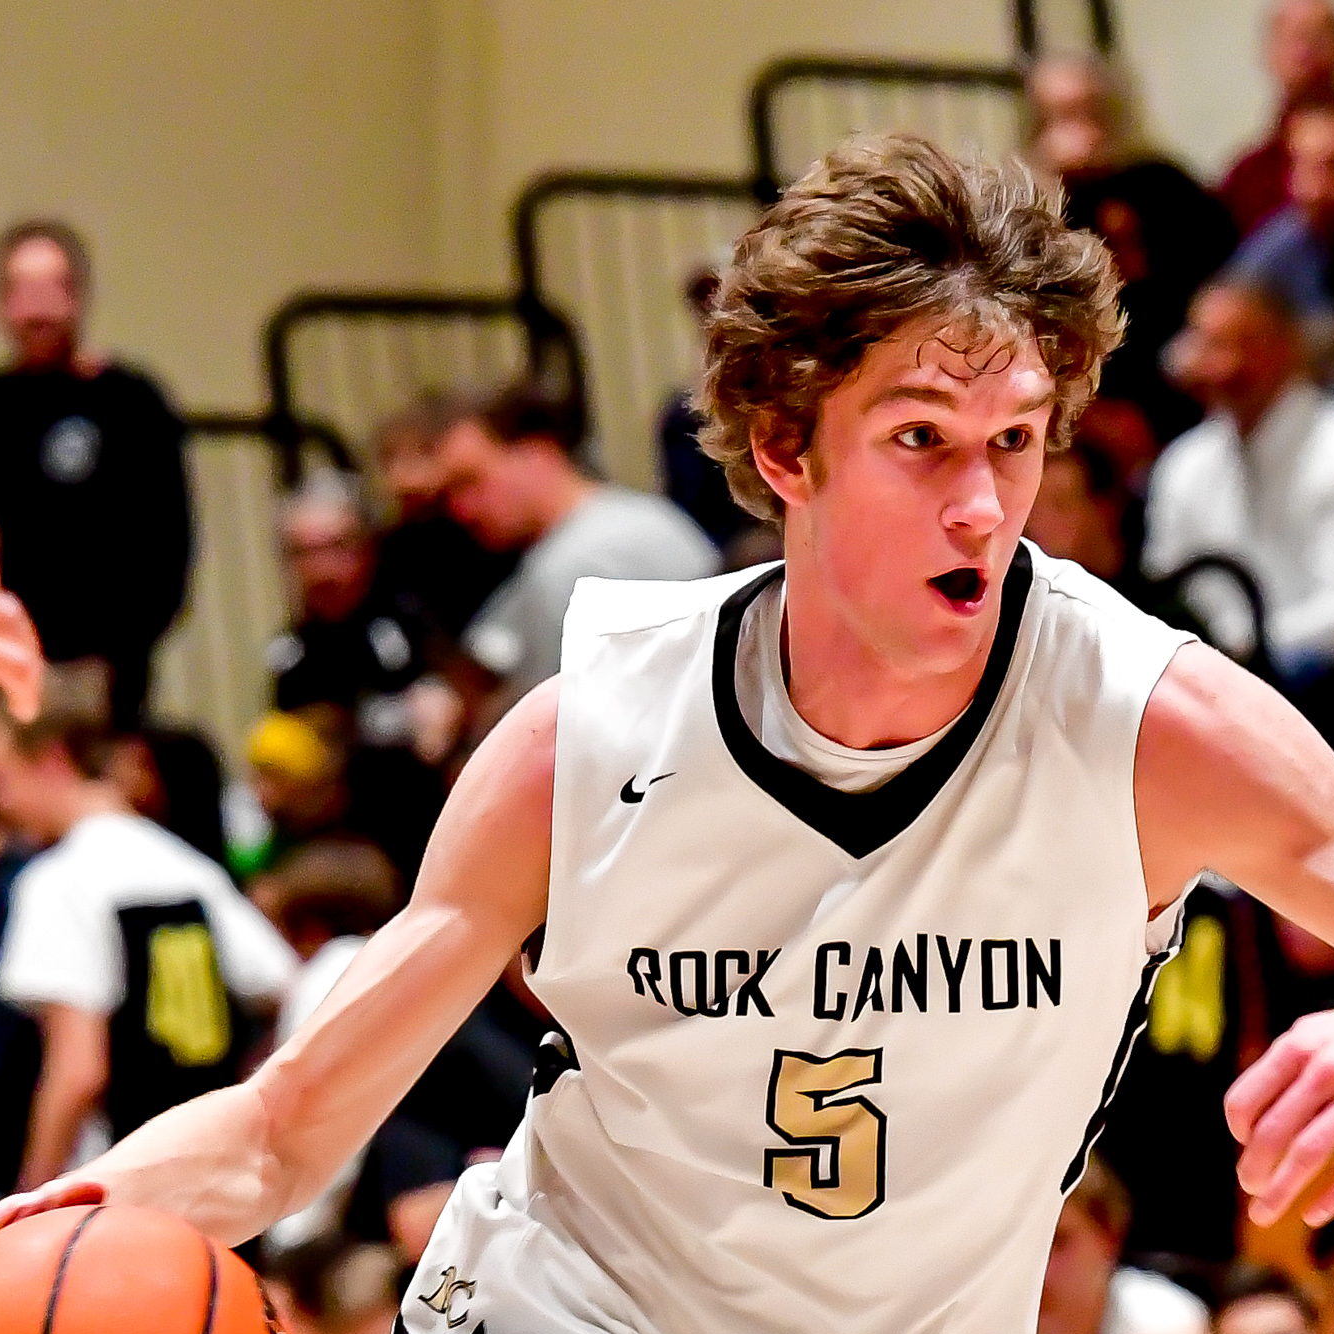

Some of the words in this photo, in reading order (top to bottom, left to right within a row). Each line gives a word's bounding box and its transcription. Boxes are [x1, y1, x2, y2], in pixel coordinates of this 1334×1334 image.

[627, 946, 783, 1018] ROCK
[812, 931, 1063, 1022] CANYON
[763, 1046, 887, 1220] 5
